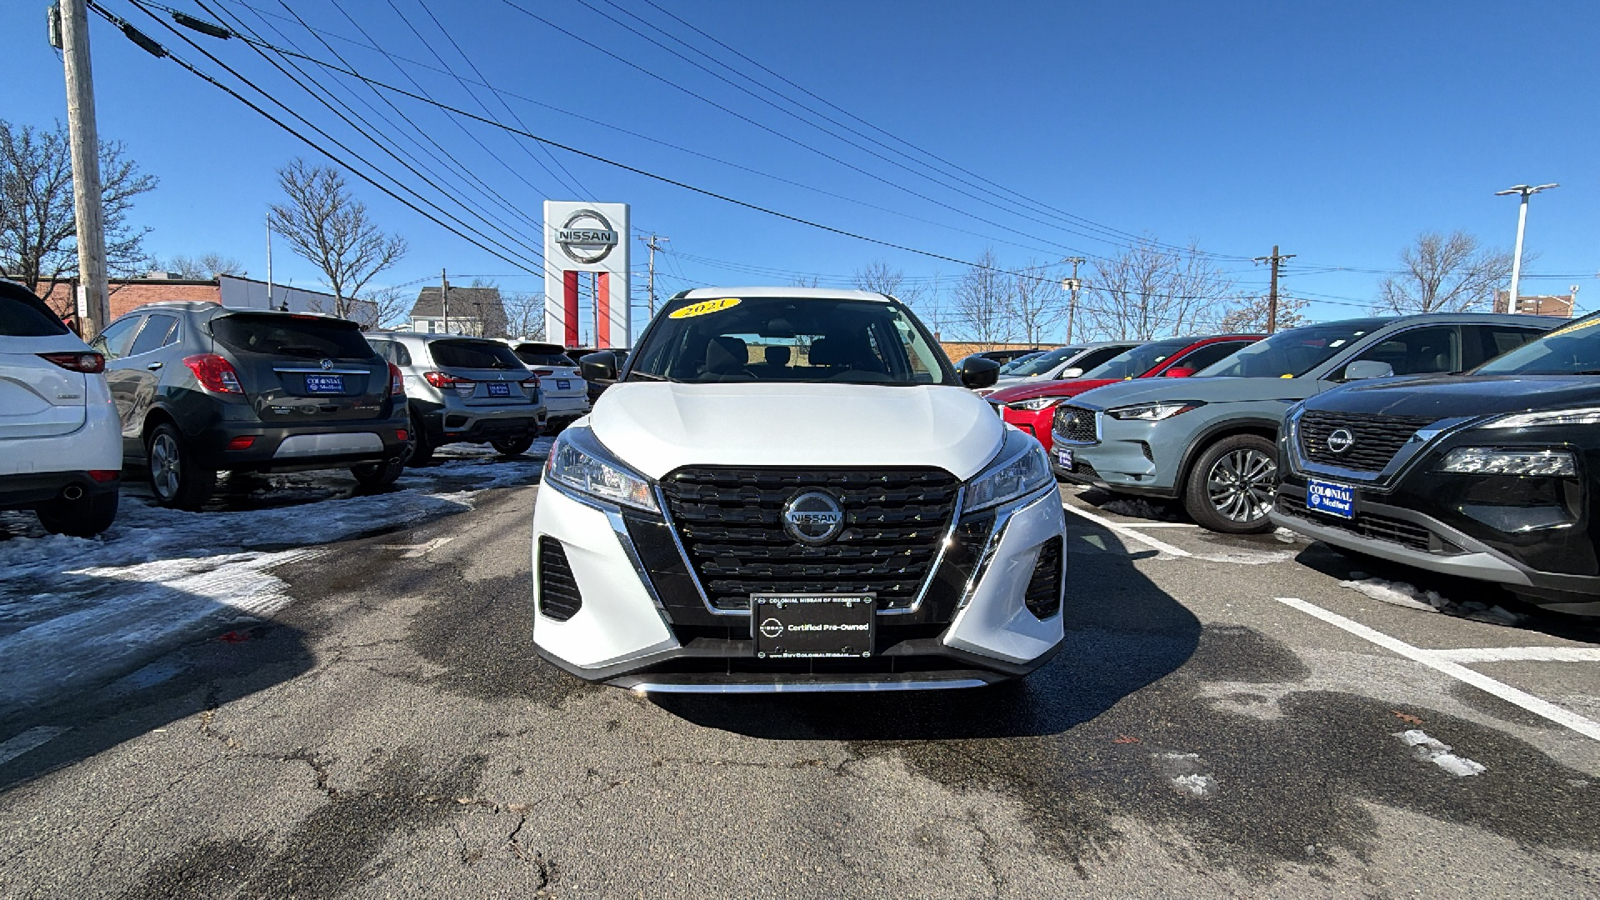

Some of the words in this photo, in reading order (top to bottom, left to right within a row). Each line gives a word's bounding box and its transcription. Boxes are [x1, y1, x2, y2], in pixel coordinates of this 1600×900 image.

[559, 231, 611, 242] NISSAN
[683, 300, 725, 316] 2021
[1309, 484, 1352, 502] COLONIAL
[1322, 497, 1350, 511] Medford
[791, 514, 837, 522] NISSAN
[823, 623, 869, 631] Pre-Owned
